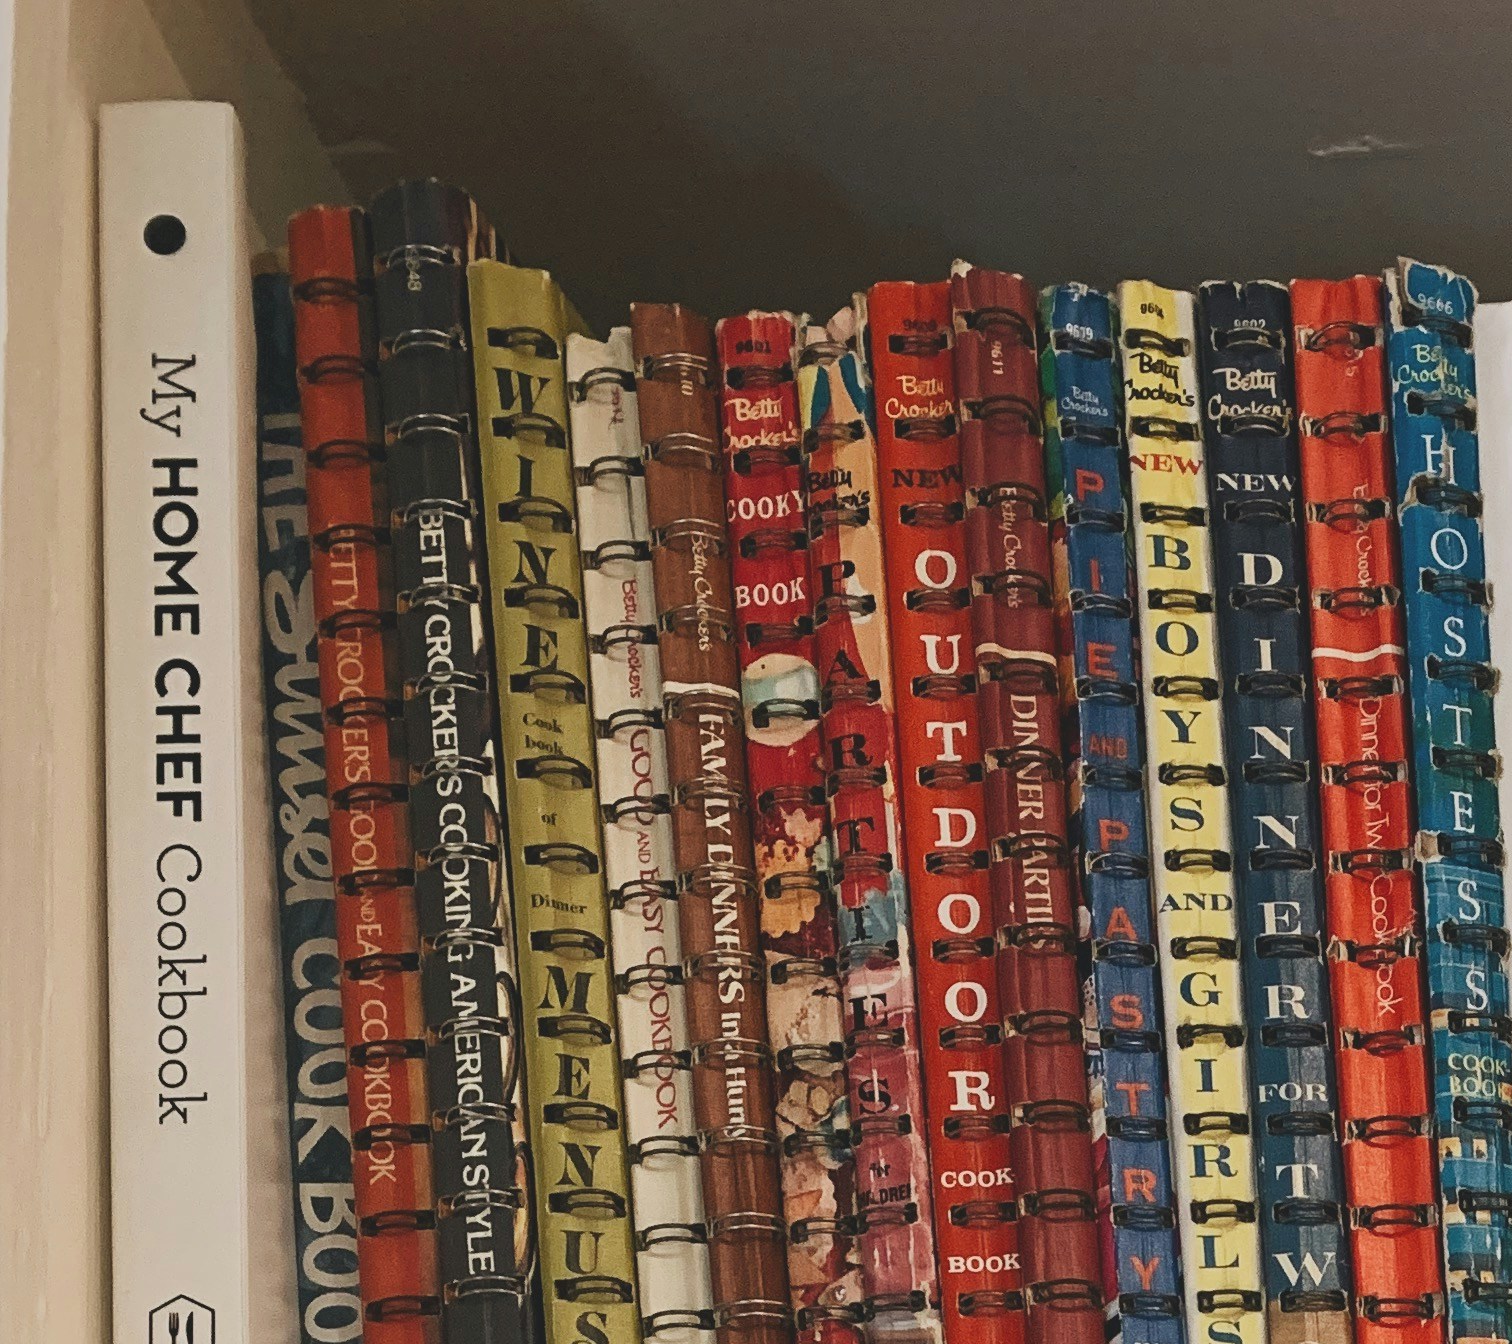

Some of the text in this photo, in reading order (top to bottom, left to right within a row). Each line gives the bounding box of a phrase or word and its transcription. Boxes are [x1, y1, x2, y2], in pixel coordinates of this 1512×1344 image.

[1130, 352, 1180, 385] Betty
[1214, 367, 1278, 403] Betty
[1070, 384, 1101, 404] Betty
[1207, 393, 1293, 422] Crocker's
[892, 467, 963, 489] NEW
[1129, 453, 1203, 477] NEW
[1216, 471, 1297, 492] NEW
[494, 368, 560, 670] WINE
[727, 490, 806, 522] COOKY
[1075, 469, 1118, 677] PIE
[736, 577, 806, 609] BOOK
[1145, 534, 1206, 833] BOYS
[140, 353, 208, 1125] My HOME CHEF Cookbook
[263, 568, 332, 907] Sunset
[522, 712, 563, 733] Cook
[1421, 434, 1488, 1011] HOSTESS
[1009, 694, 1045, 821] DINNER
[1088, 735, 1128, 757] AND
[1237, 551, 1312, 1021] DINNER
[541, 810, 558, 827] of
[913, 549, 997, 1113] OUTDOOR
[638, 830, 651, 863] AND
[436, 803, 475, 962] COOKING
[530, 893, 588, 915] Dinner
[1158, 892, 1233, 914] AND
[291, 937, 354, 1168] COOK
[449, 971, 487, 1152] AMERICAN
[1099, 818, 1161, 1291] PASTRY
[1258, 1082, 1329, 1103] FOR
[941, 1168, 1015, 1190] COOK
[462, 1159, 495, 1274] STYLE
[948, 1253, 1022, 1274] BOOK
